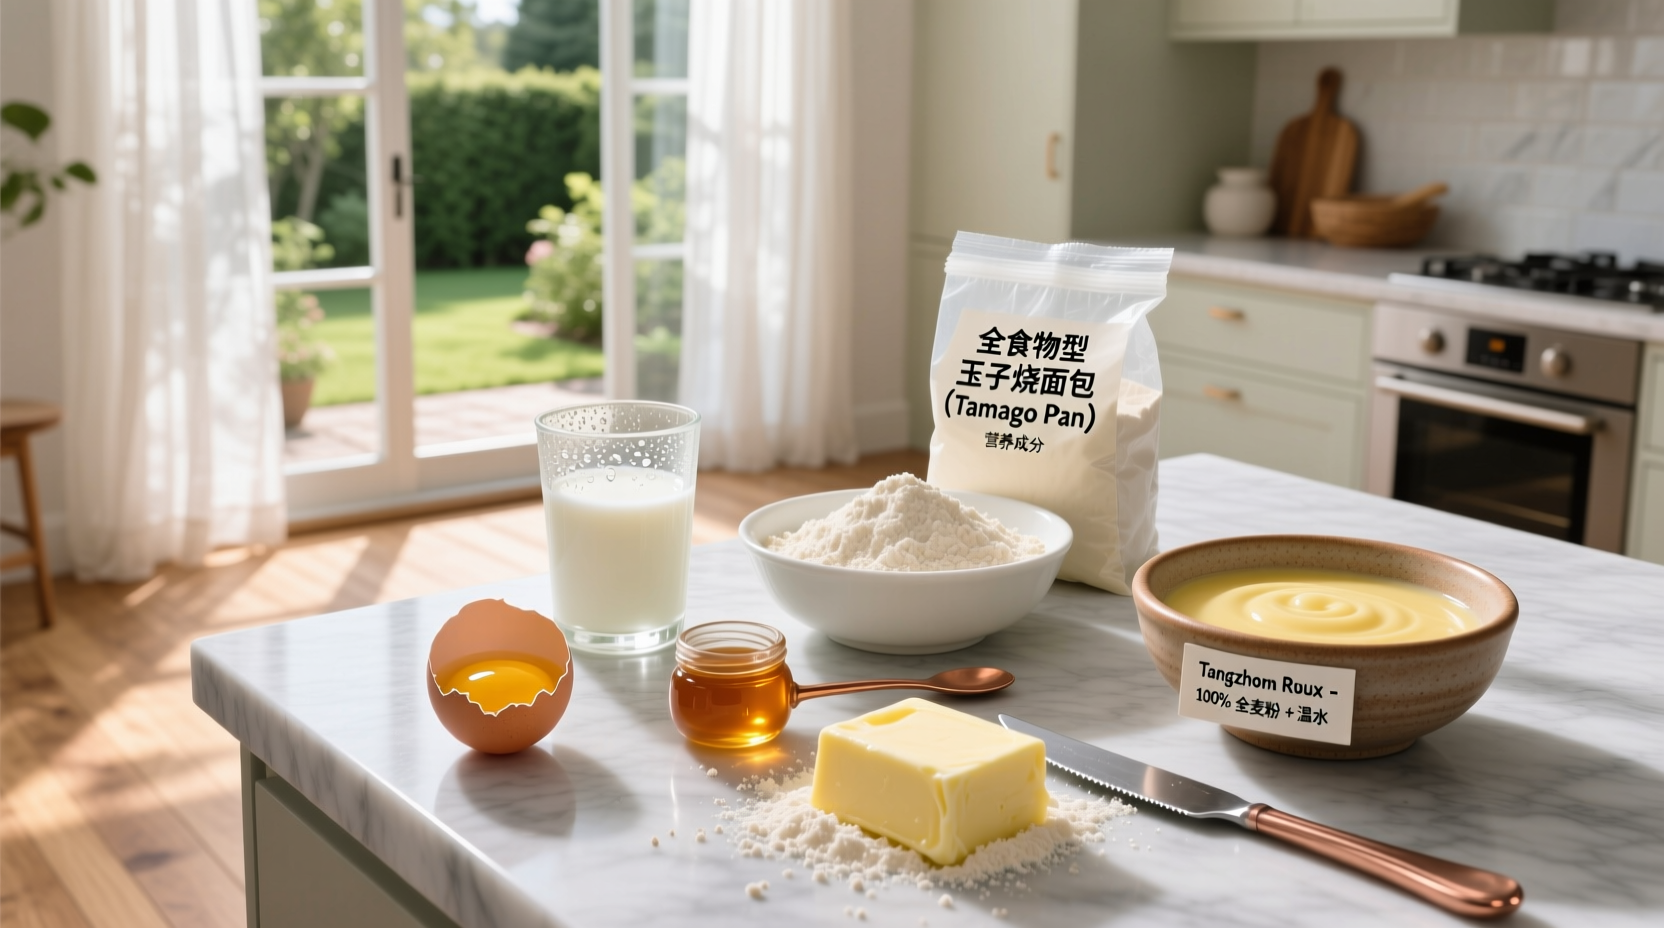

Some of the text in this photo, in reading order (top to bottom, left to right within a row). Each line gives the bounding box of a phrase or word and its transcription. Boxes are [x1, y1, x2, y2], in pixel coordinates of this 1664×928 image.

[976, 326, 1089, 363] 全食物型
[956, 359, 1095, 399] 玉子烧面包
[945, 389, 1096, 434] (Tamago Pan)
[985, 431, 1045, 453] 营养成分
[1199, 661, 1277, 691] Tangzhom
[1282, 676, 1323, 698] Roux
[1196, 688, 1328, 726] 100% 全麦粉 + 温水
